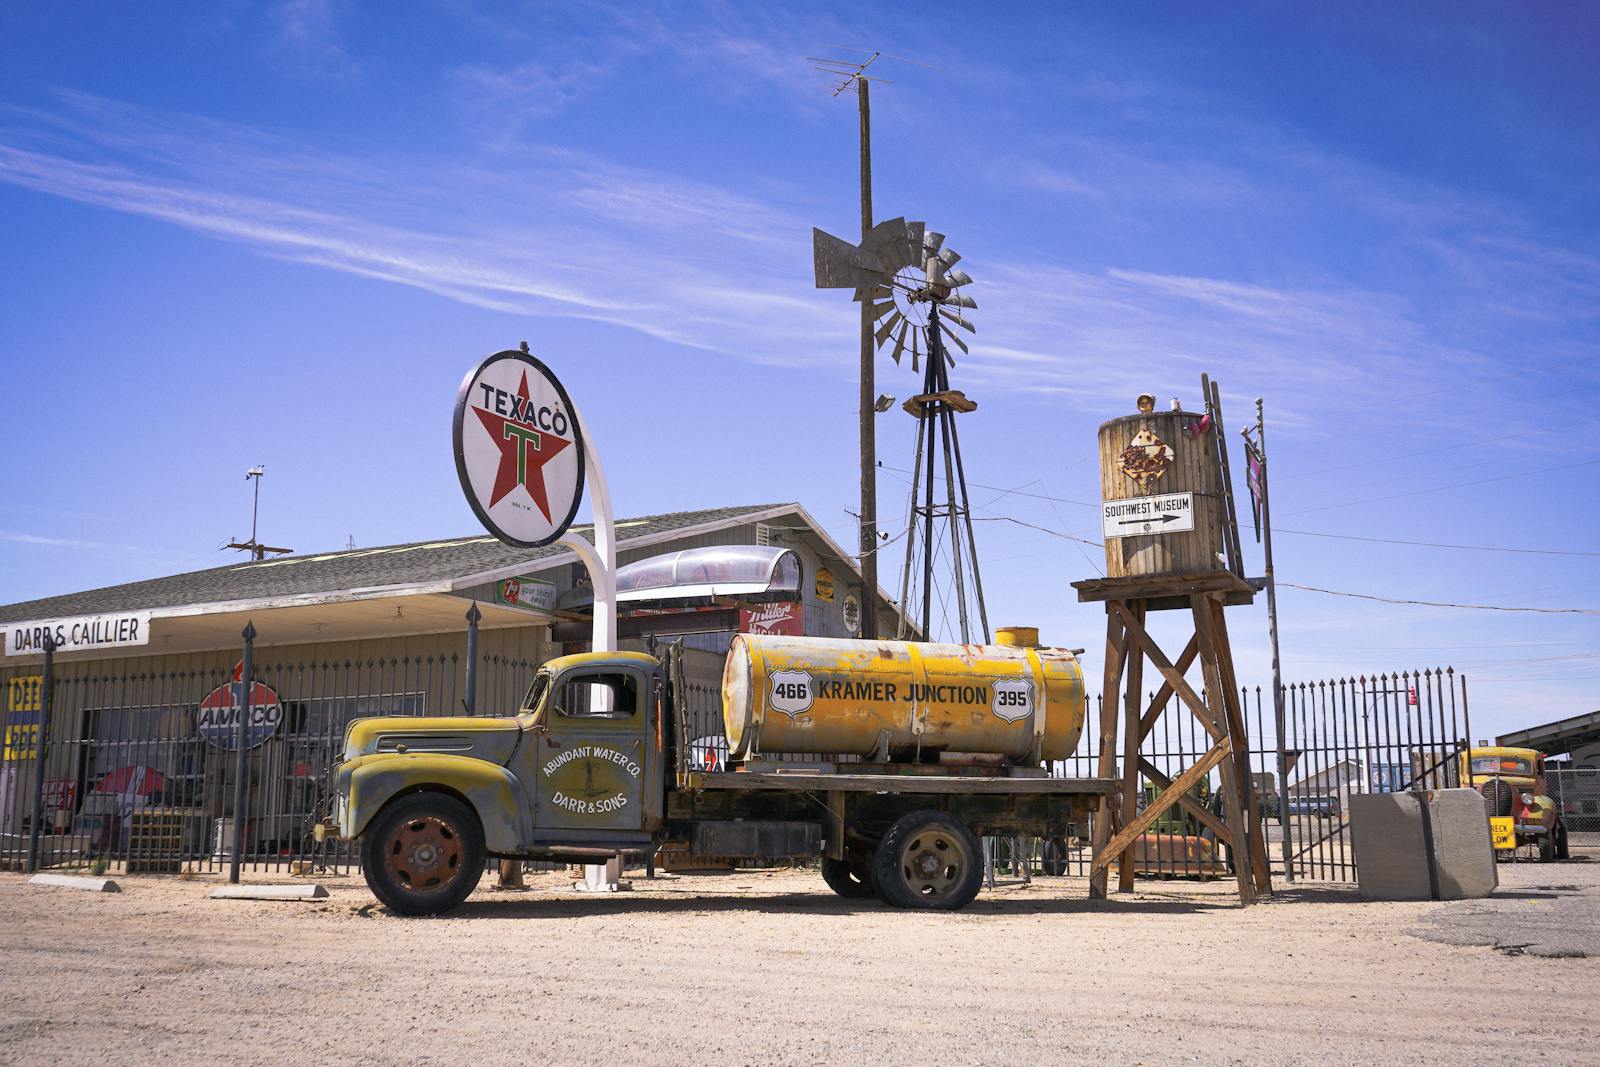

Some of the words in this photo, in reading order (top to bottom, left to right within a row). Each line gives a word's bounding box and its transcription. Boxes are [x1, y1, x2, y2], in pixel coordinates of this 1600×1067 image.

[480, 382, 568, 436] TEXACO
[504, 422, 541, 487] T
[1105, 502, 1151, 518] SOUTHWEST
[1154, 497, 1189, 512] MUSEUM
[746, 602, 791, 623] Miller
[55, 624, 66, 646] &
[71, 617, 139, 645] CAILLIER
[775, 683, 807, 699] 466
[819, 681, 897, 702] KRAMER
[903, 683, 987, 705] JUNCTION
[999, 691, 1027, 707] 395
[543, 747, 592, 778] ABUNDANT
[593, 746, 628, 767] WATER
[626, 762, 641, 778] CO.
[552, 791, 587, 814] DARR
[596, 793, 628, 813] SONS
